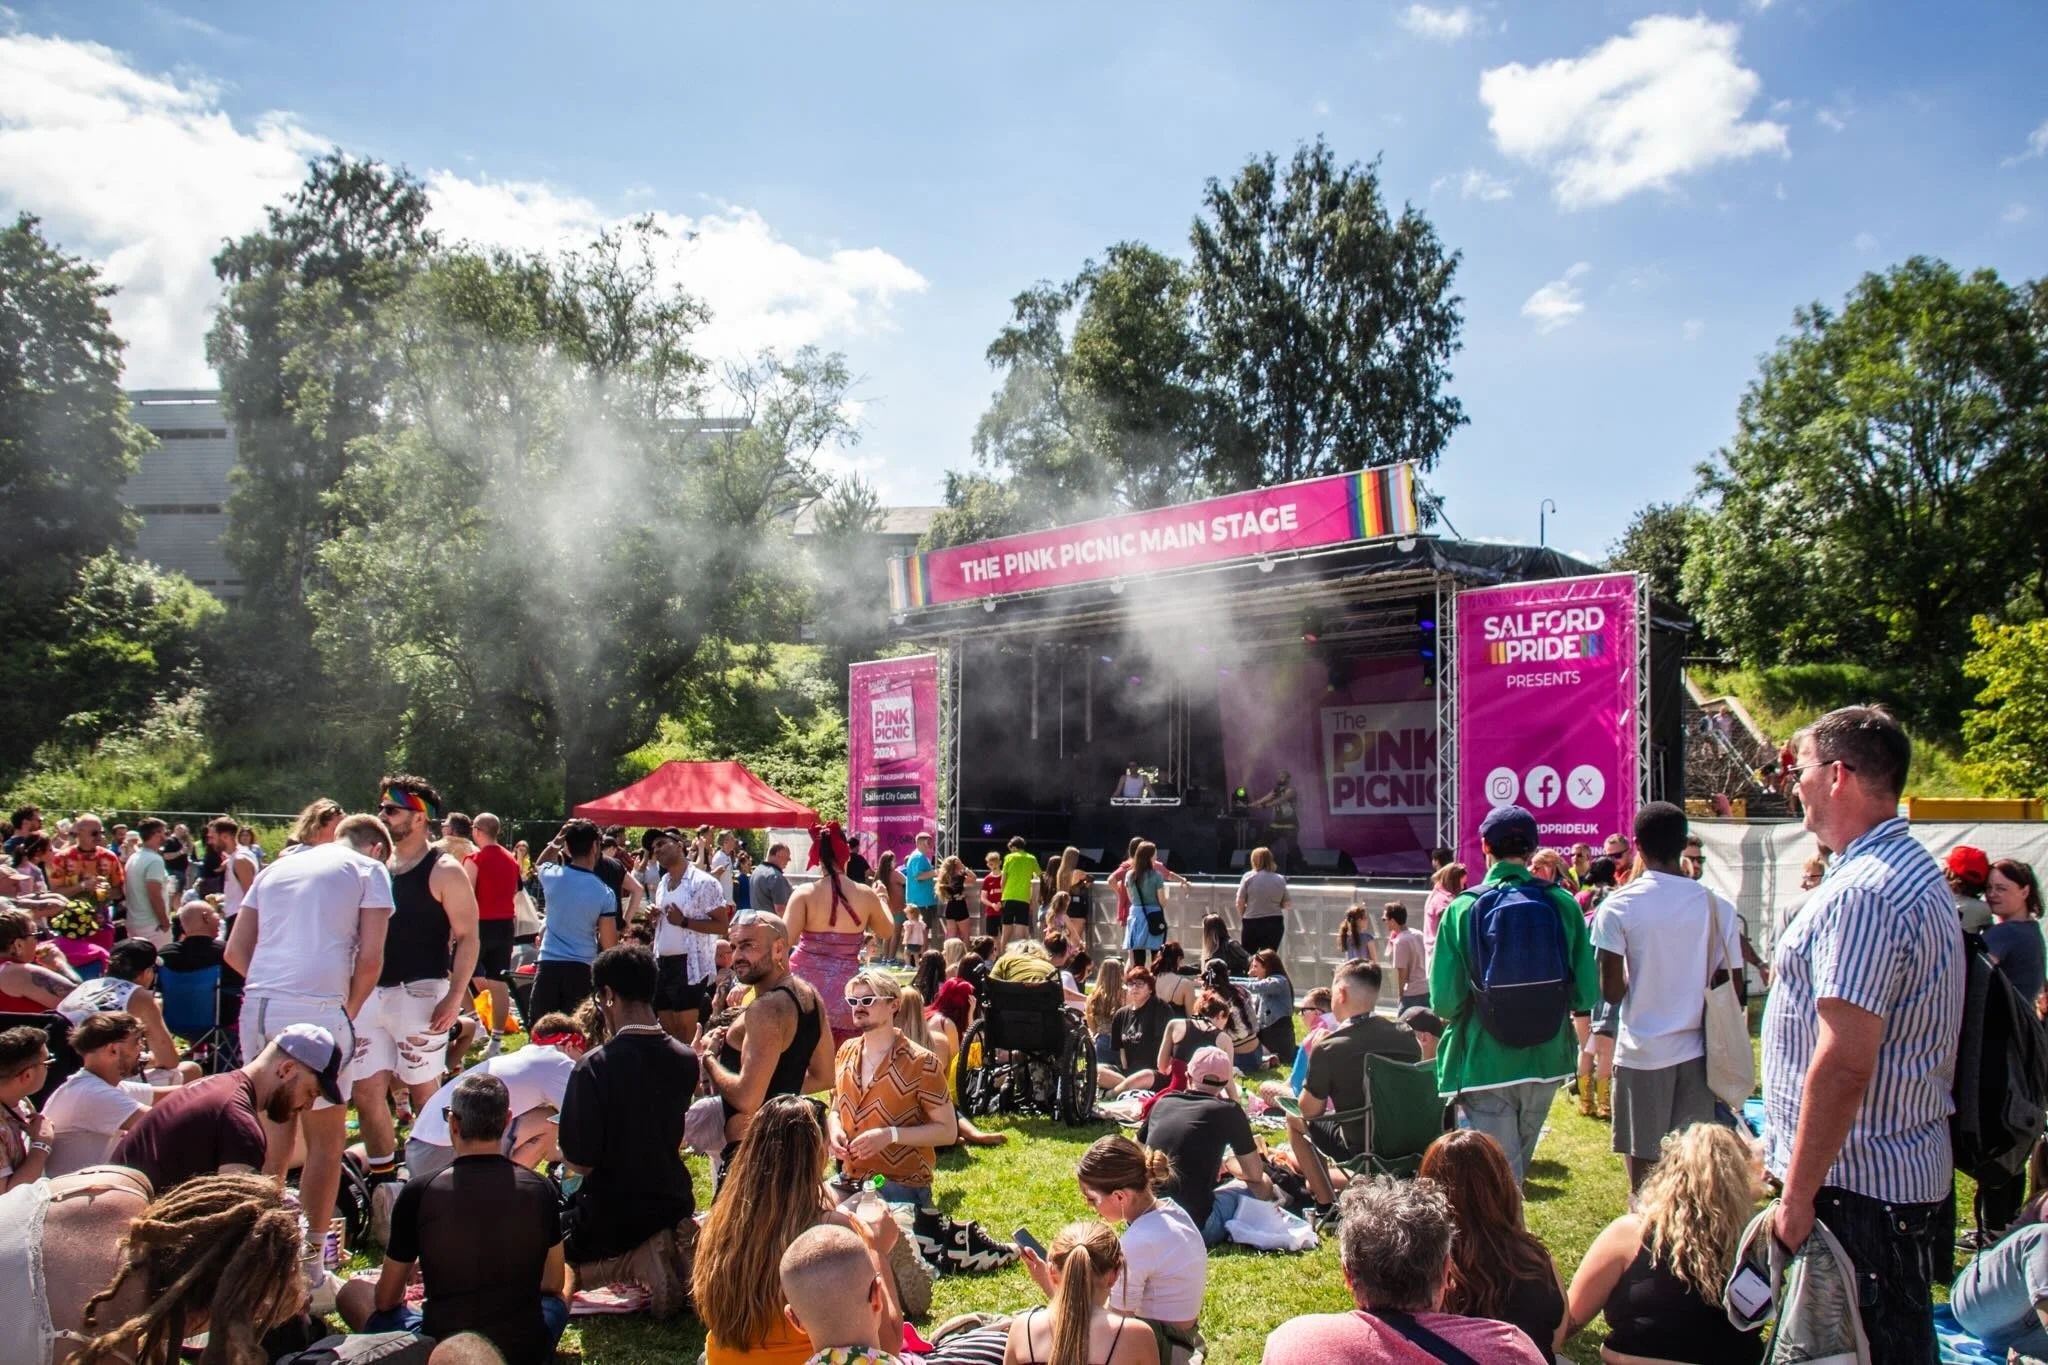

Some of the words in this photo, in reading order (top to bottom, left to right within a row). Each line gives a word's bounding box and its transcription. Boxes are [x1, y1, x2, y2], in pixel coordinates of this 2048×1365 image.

[960, 555, 1002, 584] THE
[1004, 546, 1058, 577] PINK
[1060, 532, 1136, 568] PICNIC
[1139, 519, 1206, 553] MAIN
[1211, 503, 1298, 542] STAGE
[1483, 606, 1606, 641] SALFORD
[1505, 634, 1581, 664] PRIDE
[1506, 670, 1582, 689] PRESENTS
[875, 708, 910, 727] PINK
[1331, 710, 1368, 730] The
[875, 726, 910, 740] PICNIC
[873, 746, 896, 759] 2024
[1333, 727, 1447, 773] PINK
[864, 792, 885, 801] Salford
[885, 792, 896, 803] City
[896, 791, 917, 800] Council
[1333, 773, 1448, 808] PICNIC
